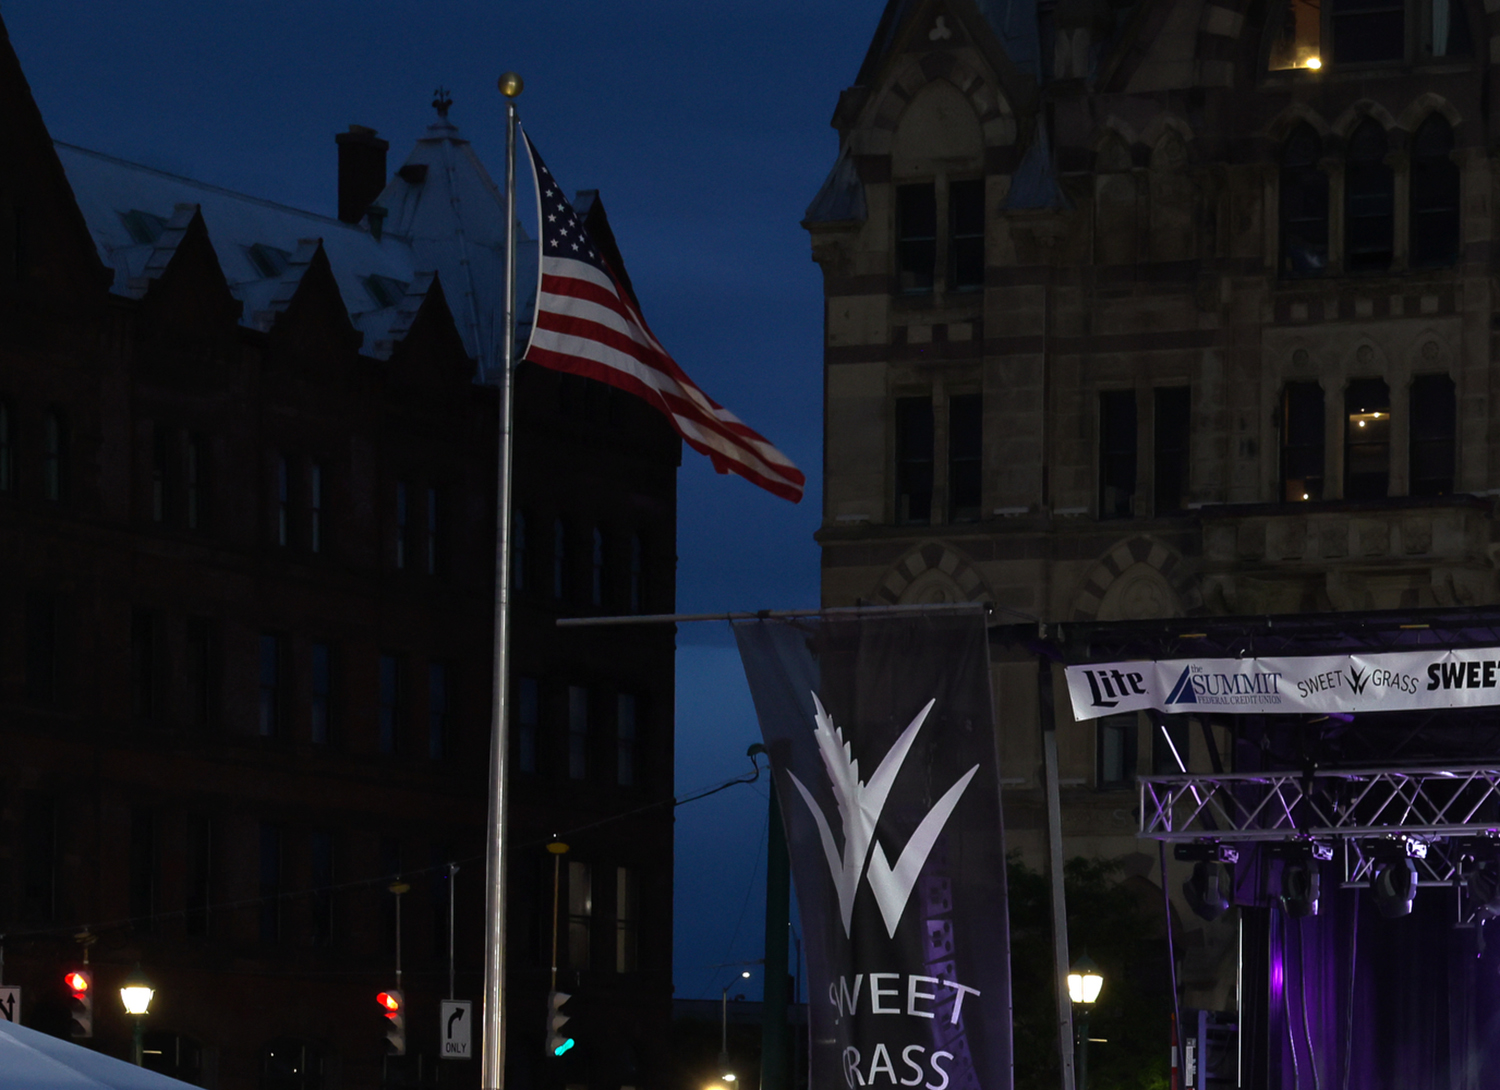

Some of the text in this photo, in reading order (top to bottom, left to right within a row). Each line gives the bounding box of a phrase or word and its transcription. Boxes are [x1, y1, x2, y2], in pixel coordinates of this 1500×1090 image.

[1190, 664, 1203, 672] the
[1082, 669, 1146, 707] Lite
[1192, 673, 1282, 695] SUMMIT
[1297, 668, 1420, 698] SWEET GRASS
[1196, 694, 1282, 704] FEDERAL CREDIT UNION
[446, 1041, 467, 1054] ONLY
